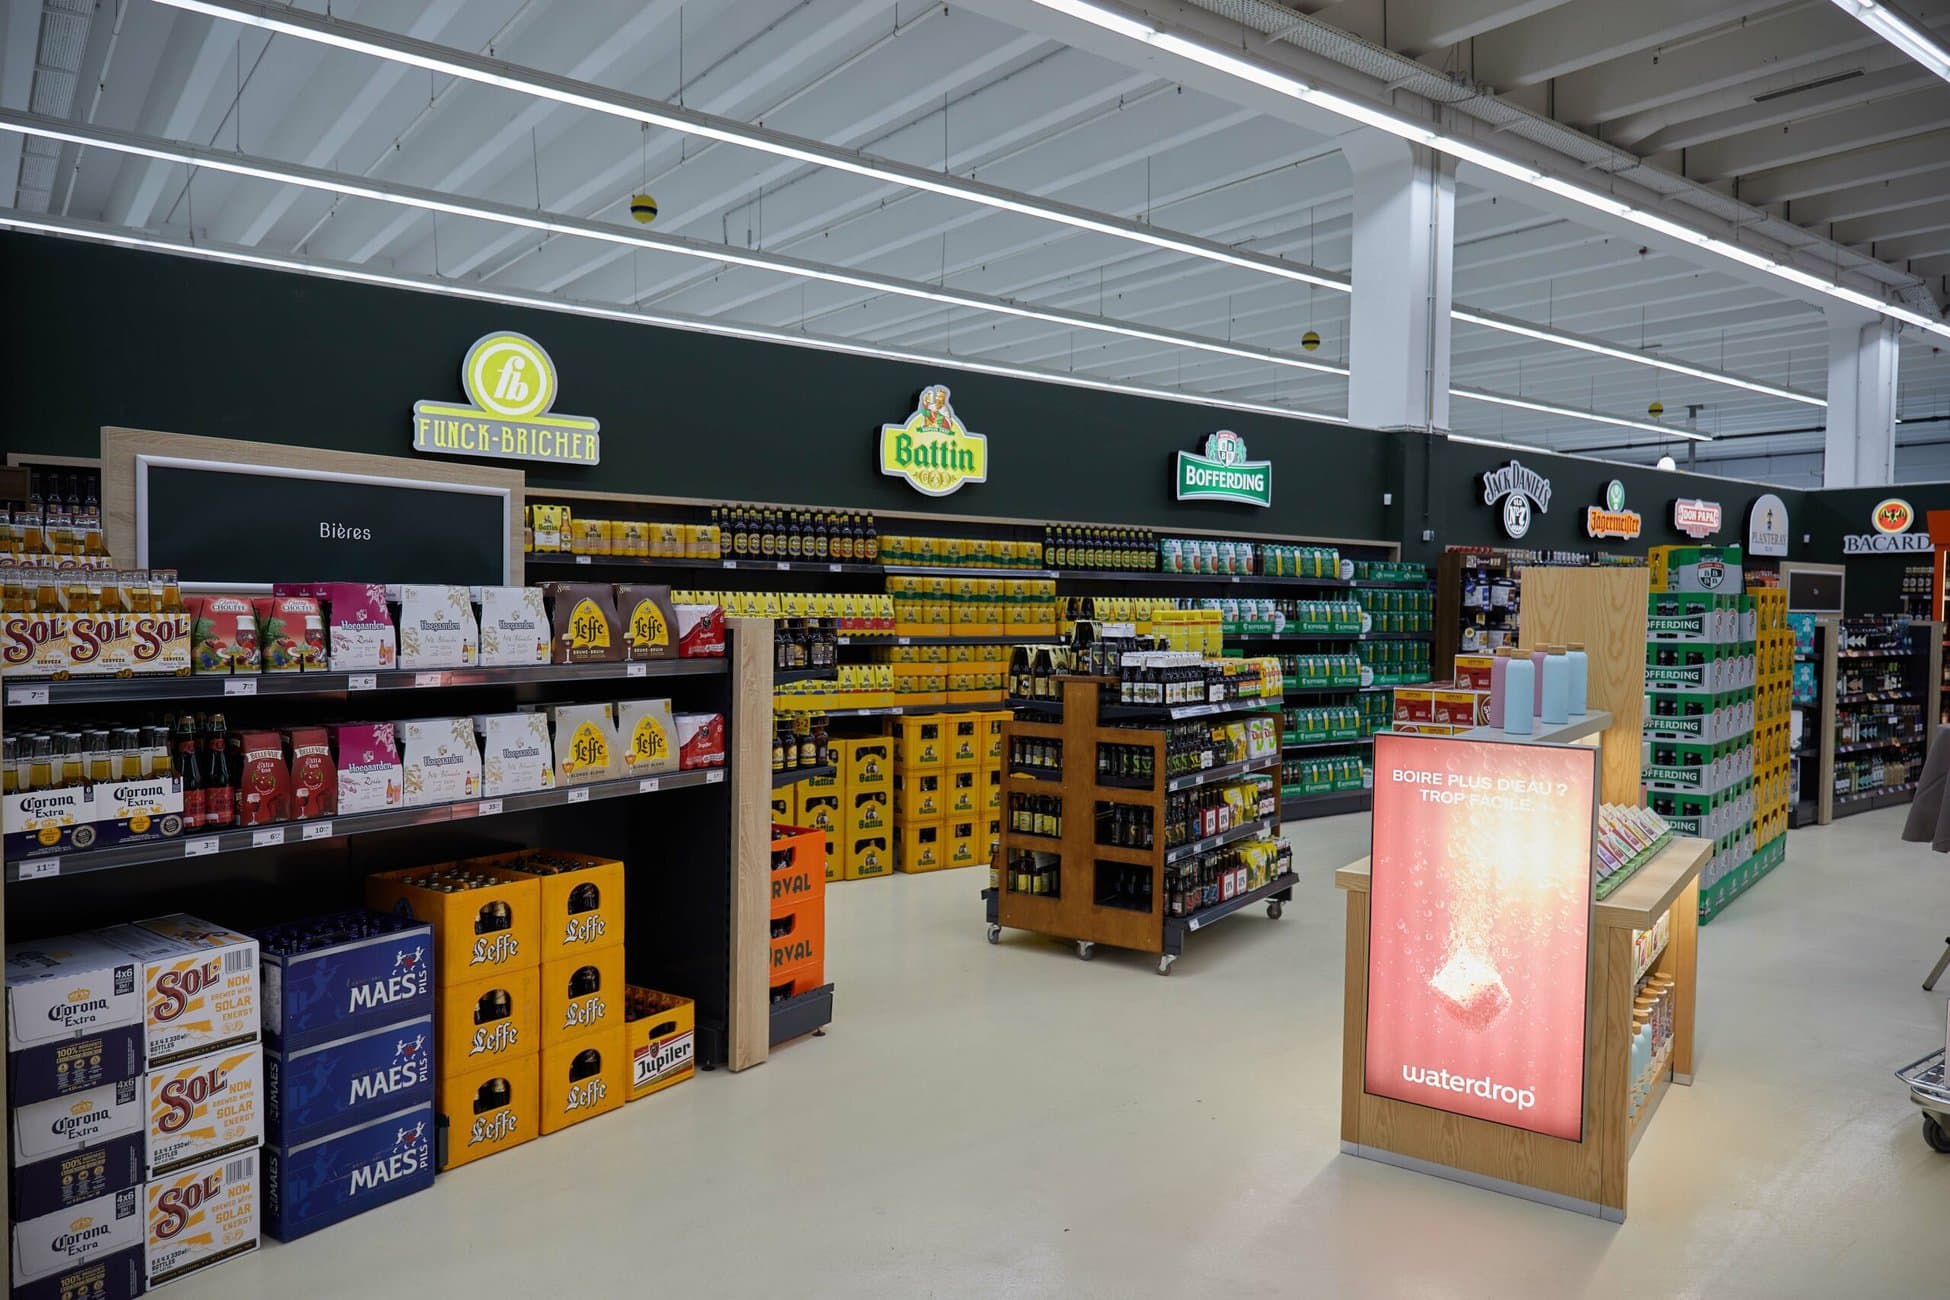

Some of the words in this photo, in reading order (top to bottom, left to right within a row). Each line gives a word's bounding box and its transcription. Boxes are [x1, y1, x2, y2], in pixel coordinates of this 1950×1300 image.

[418, 418, 597, 461] FUNCK-BRICHER
[895, 433, 975, 471] Battin
[1185, 464, 1265, 492] BOFFERDING
[1485, 466, 1512, 503] JACK
[1682, 508, 1697, 521] DON
[1697, 510, 1714, 523] PAPA
[320, 522, 372, 541] Bières
[1847, 535, 1931, 551] BACARD
[341, 620, 386, 632] Hoegaarden
[420, 619, 461, 632] Hoegaarden
[498, 619, 535, 631] Hoegaarden
[574, 616, 604, 643] Leffe
[634, 615, 663, 642] Leffe
[1647, 618, 1699, 630] FFERDING
[1645, 668, 1699, 681] OFFERDING
[503, 746, 540, 758] Hoegaarden
[574, 737, 604, 768] Leffe
[636, 731, 664, 761] Leffe
[348, 760, 393, 774] Hoegaarden
[423, 754, 464, 767] Hoegaarden
[114, 785, 164, 801] Corona
[1392, 769, 1443, 785] BOIRE
[1447, 774, 1493, 789] PLUS
[1497, 778, 1553, 796] D'EAU
[20, 795, 74, 813] Corona
[127, 798, 154, 807] Extra
[1419, 788, 1466, 805] TROP
[35, 809, 64, 818] Extra
[772, 872, 811, 900] RVAL
[563, 914, 606, 944] Leffe
[469, 934, 519, 966] Leffe
[769, 939, 813, 968] RVAL
[227, 974, 250, 988] NOW
[349, 972, 417, 1014] MAES
[418, 967, 428, 994] PILS
[48, 998, 107, 1022] Corona
[215, 995, 251, 1012] SOLAR
[563, 997, 606, 1029] Leffe
[64, 1015, 96, 1028] Extra
[469, 1022, 519, 1056] Leffe
[637, 1042, 691, 1079] Jupiler
[229, 1080, 252, 1093] NOW
[349, 1061, 418, 1105] MAES
[419, 1056, 428, 1082] PILS
[1402, 1064, 1536, 1111] waterdrop
[564, 1079, 607, 1114] Leffe
[216, 1101, 253, 1119] SOLAR
[52, 1109, 109, 1135] Corona
[68, 1126, 99, 1140] Extra
[468, 1109, 518, 1147] Leffe
[350, 1149, 418, 1196] MAES
[419, 1143, 428, 1169] PILS
[228, 1183, 251, 1197] NOW
[216, 1203, 251, 1224] SOLAR
[52, 1224, 110, 1252] Corona
[68, 1241, 98, 1256] Extra
